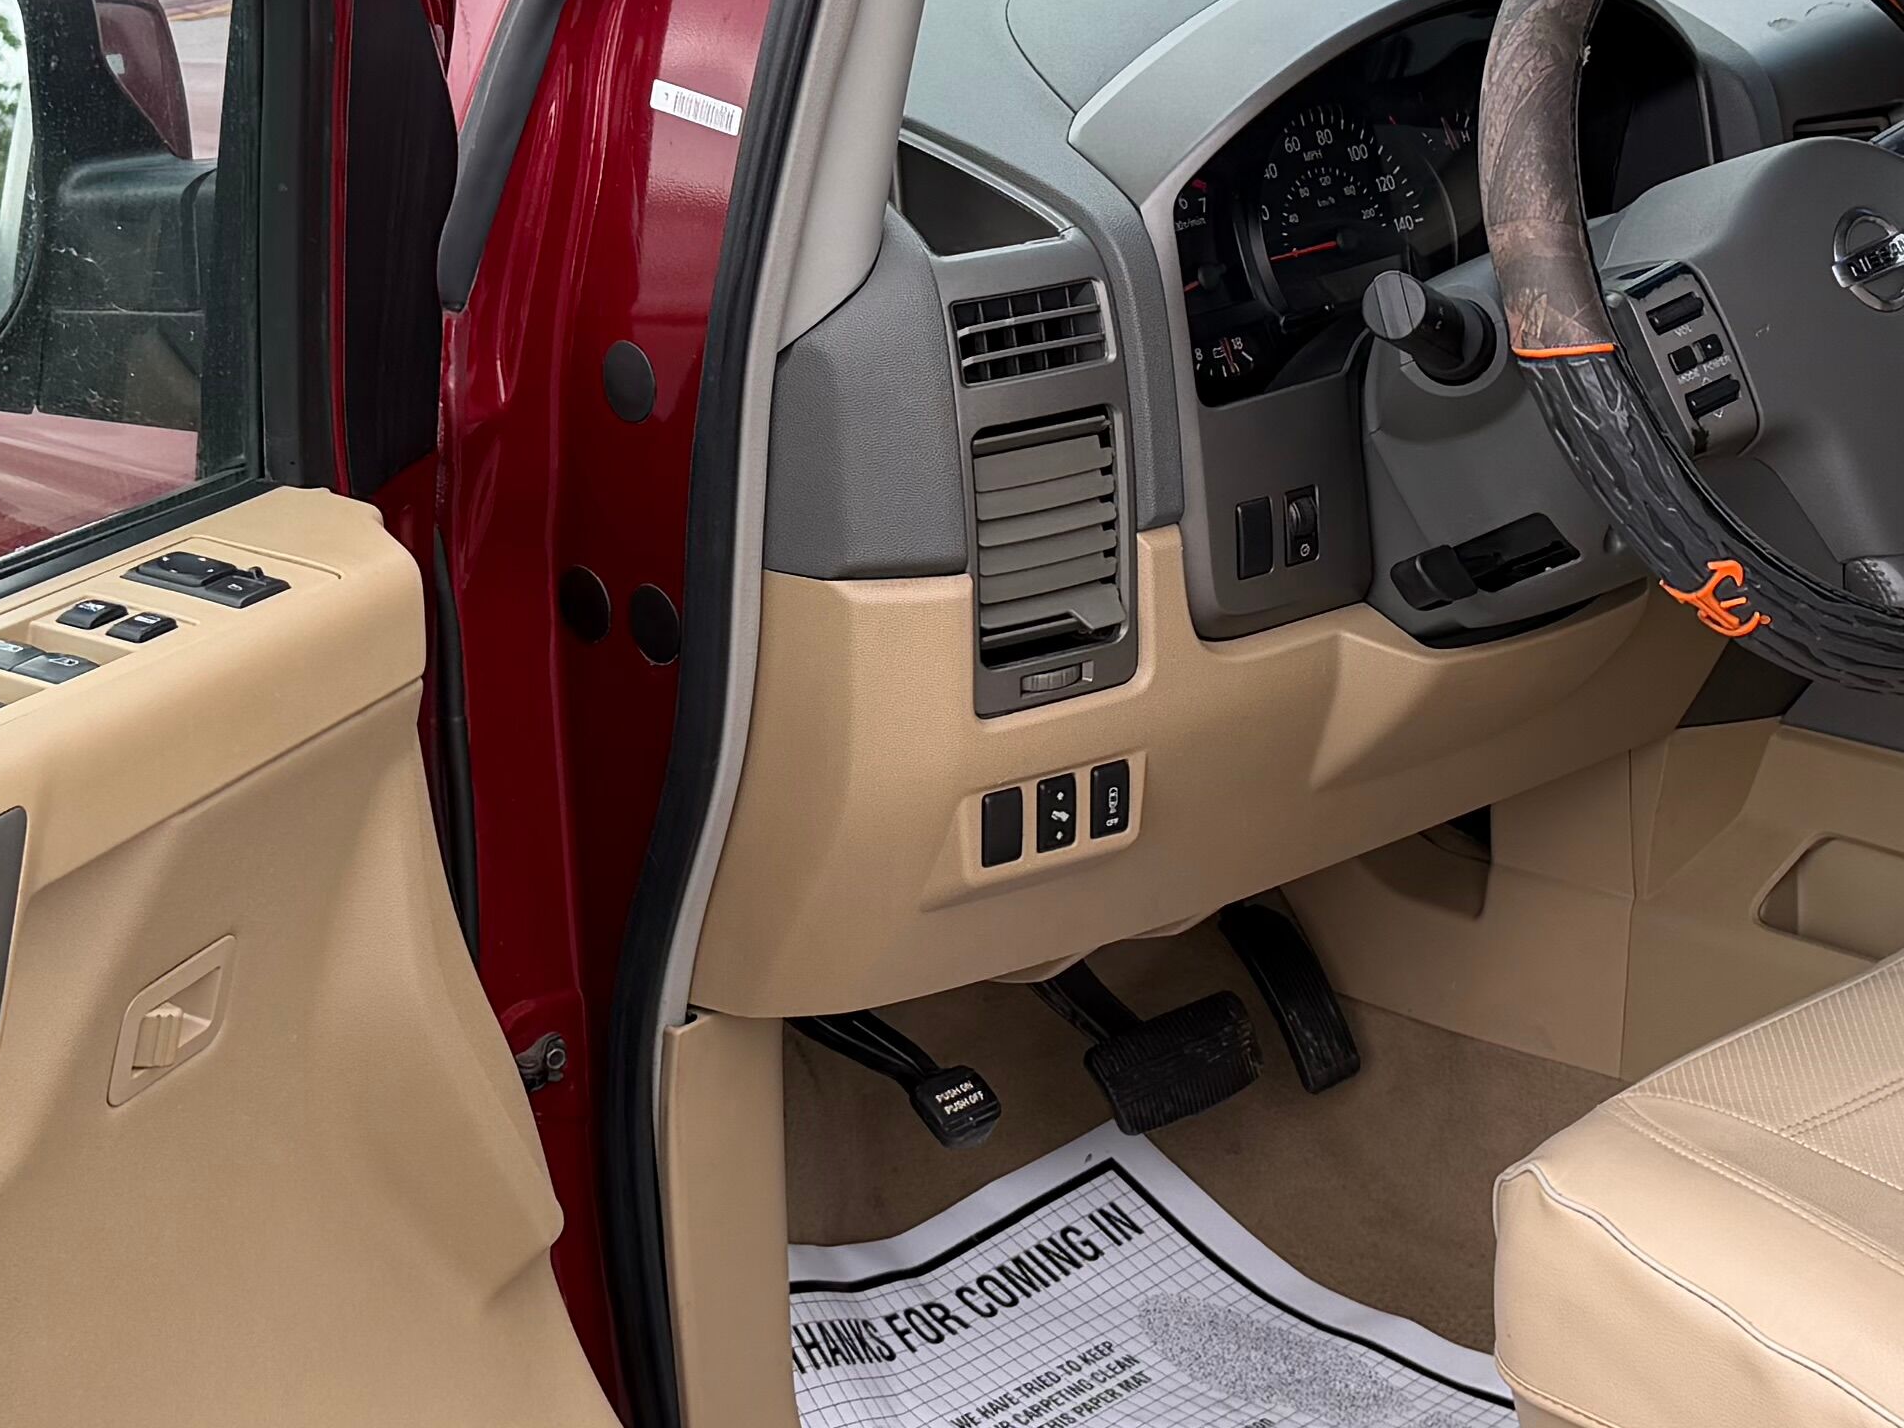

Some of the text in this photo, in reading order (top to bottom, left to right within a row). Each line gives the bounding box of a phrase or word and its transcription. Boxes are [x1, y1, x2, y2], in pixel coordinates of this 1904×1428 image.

[1284, 136, 1301, 153] 60
[1316, 129, 1333, 146] 80
[1303, 150, 1323, 162] MPH
[1347, 143, 1368, 162] 100
[1376, 174, 1396, 192] 120
[1178, 192, 1189, 210] 6
[1197, 197, 1207, 213] 7
[1393, 216, 1415, 233] 140
[1194, 347, 1204, 361] 8
[935, 1086, 962, 1103] PUSH
[943, 1097, 971, 1115] PUSH
[884, 1301, 971, 1354] FOR
[955, 1224, 1105, 1319] COMING
[1088, 1201, 1145, 1247] IN
[976, 1391, 1020, 1421] HAVE
[1014, 1372, 1062, 1399] TRIED
[1056, 1359, 1082, 1377] TO
[1077, 1340, 1117, 1366] KEEP
[1012, 1378, 1094, 1426] CARPETING
[1091, 1354, 1141, 1384] CLEAN
[1070, 1388, 1124, 1418] PAPER
[1118, 1370, 1153, 1394] MAT
